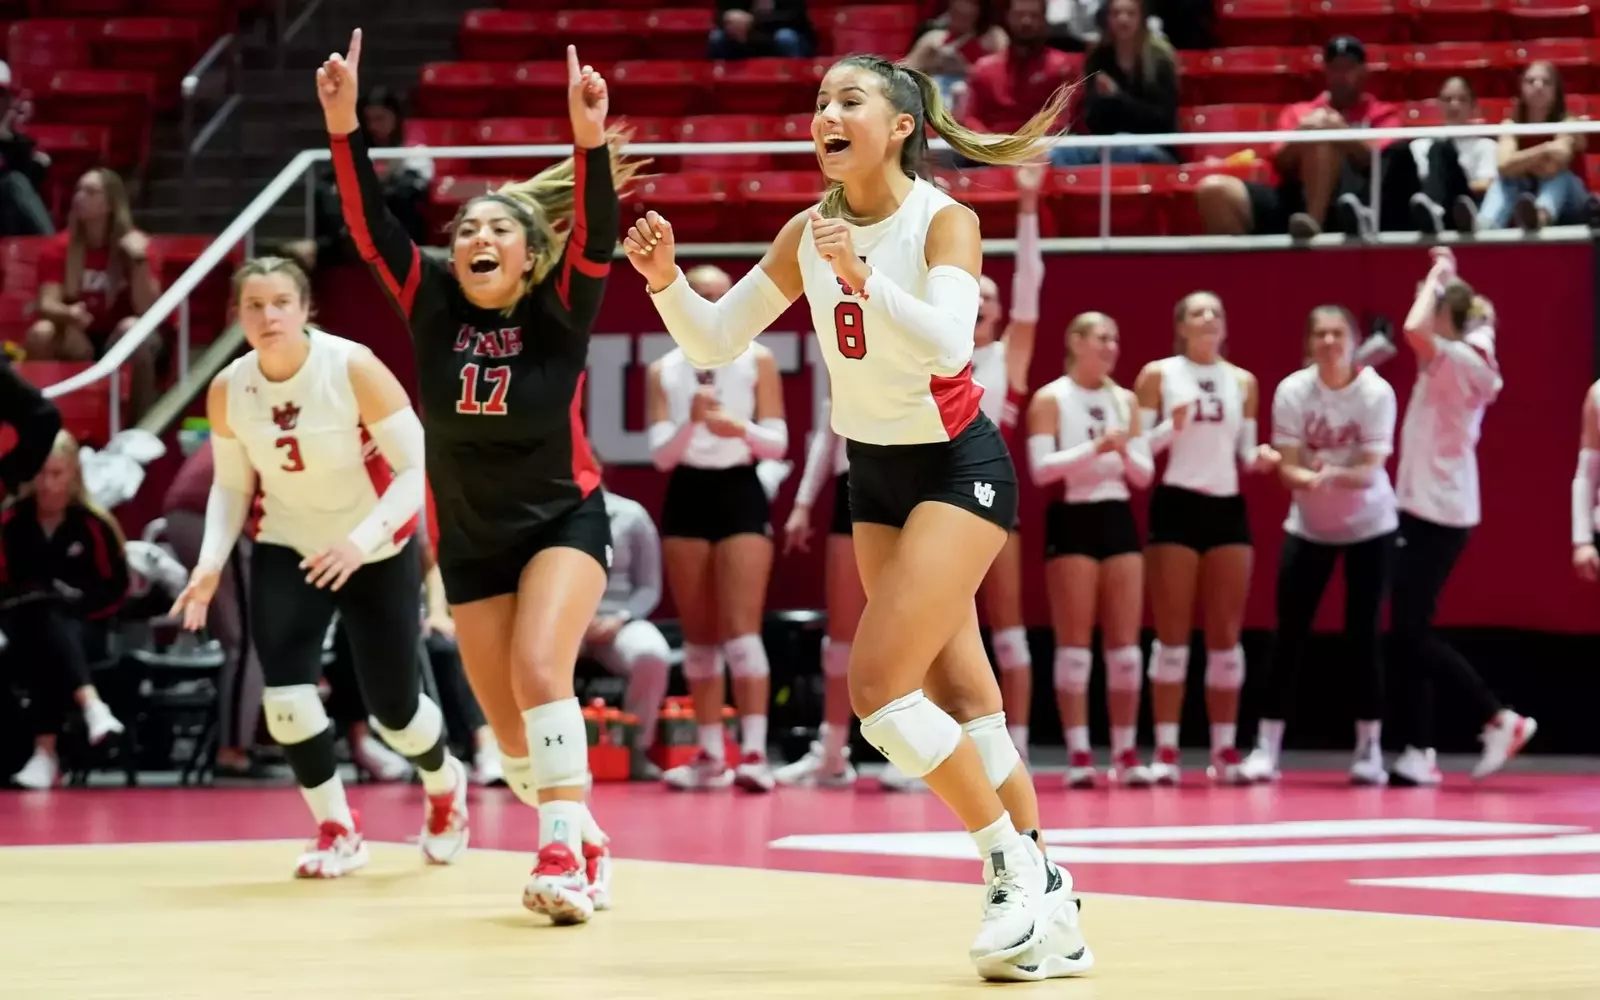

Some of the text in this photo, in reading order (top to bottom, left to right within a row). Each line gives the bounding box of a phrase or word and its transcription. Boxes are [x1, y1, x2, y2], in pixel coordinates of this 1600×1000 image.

[834, 301, 868, 360] 8
[456, 362, 512, 416] 17
[1194, 398, 1224, 422] 13
[275, 436, 305, 472] 3
